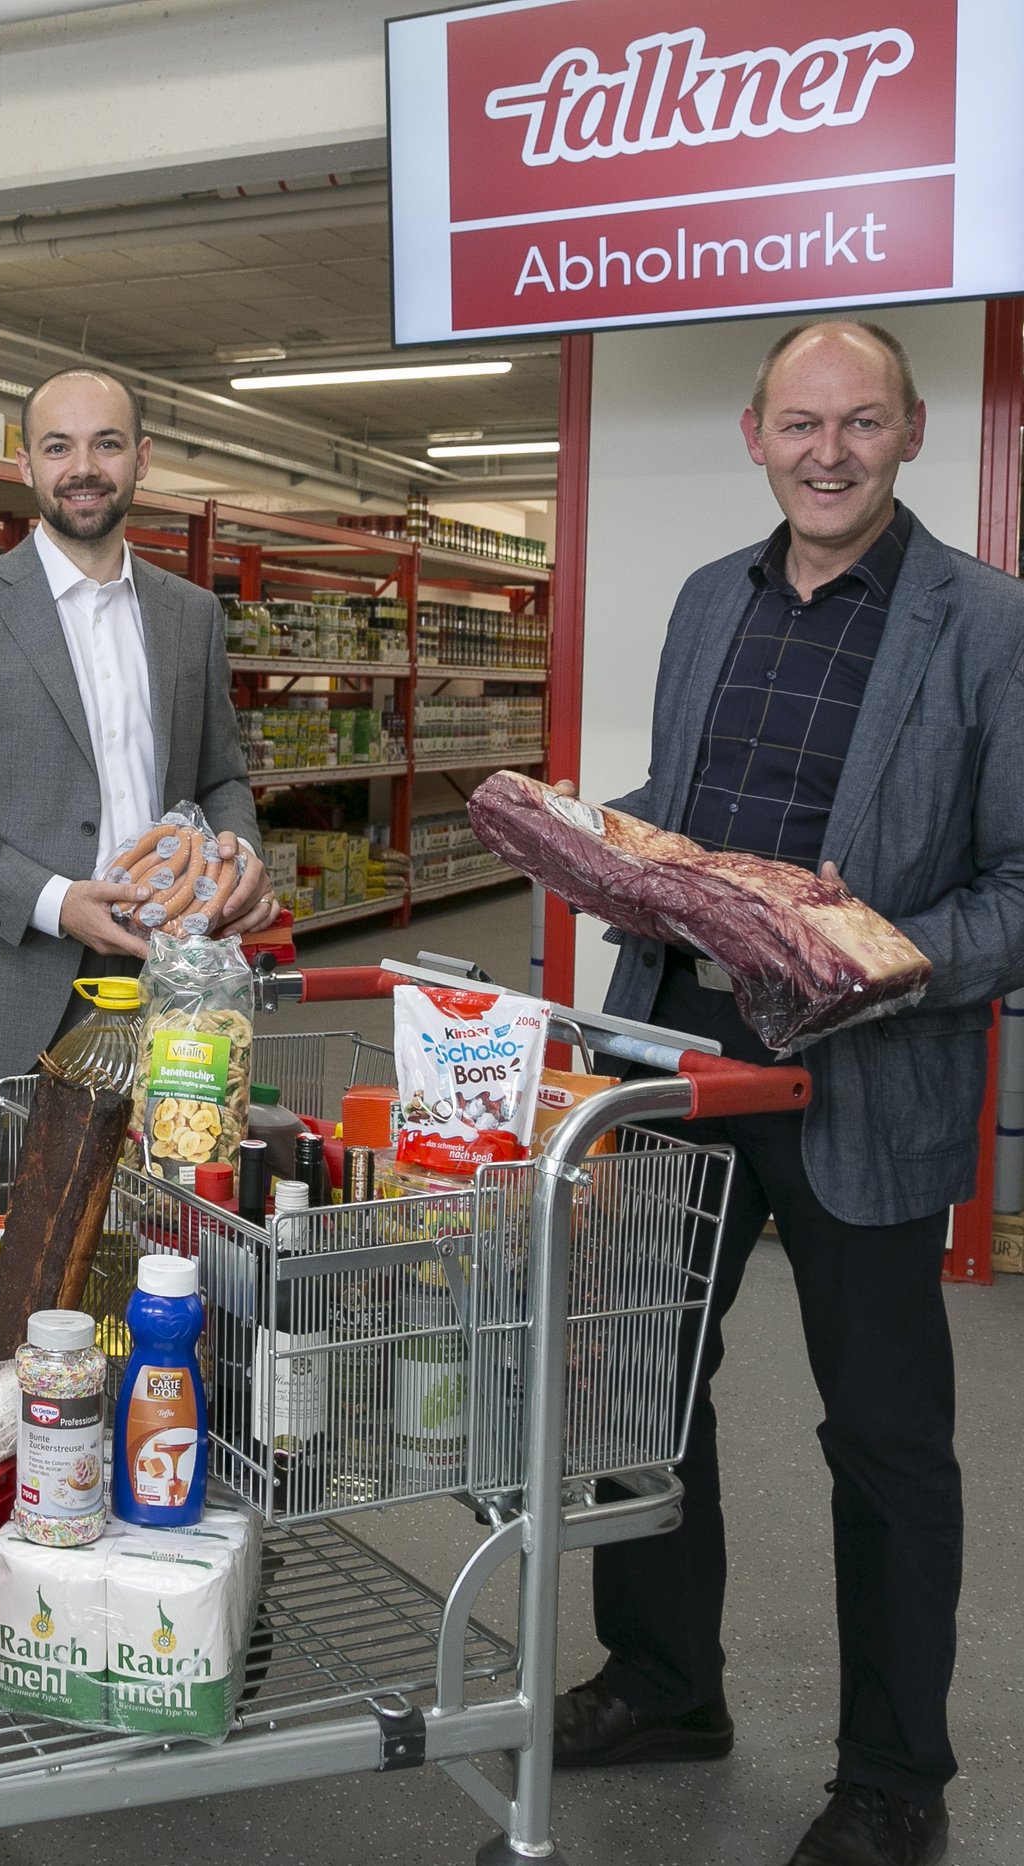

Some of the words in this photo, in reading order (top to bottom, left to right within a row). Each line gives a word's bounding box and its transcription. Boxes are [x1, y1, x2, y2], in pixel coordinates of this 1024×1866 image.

[485, 27, 915, 167] falkner
[513, 212, 887, 296] Abholmarkt
[515, 1017, 541, 1030] 200g
[445, 1026, 490, 1040] Kinder
[172, 1045, 207, 1062] Vitality
[437, 1040, 524, 1065] Schoko-
[160, 1066, 215, 1082] Bananenchips
[453, 1064, 507, 1085] Bons
[426, 1140, 437, 1148] das
[437, 1142, 465, 1151] schmeckt
[449, 1150, 471, 1160] nach
[472, 1151, 493, 1162] Spaß
[992, 1241, 1012, 1256] UR
[149, 1378, 181, 1391] CARTE
[153, 1388, 178, 1399] D'OR
[39, 1406, 58, 1416] Oetker
[157, 1409, 175, 1419] Toffee
[60, 1414, 99, 1427] Professional
[29, 1432, 51, 1443] Bunte
[29, 1441, 85, 1453] Zuckerstreusel
[0, 1624, 88, 1666] Rauch
[117, 1643, 211, 1677] Rauch
[0, 1661, 67, 1695] mehl
[0, 1682, 41, 1698] Weizenmehl
[40, 1691, 59, 1705] Type
[59, 1696, 73, 1705] 700
[117, 1680, 192, 1709] mehl
[118, 1701, 164, 1716] Weizenmehl
[164, 1708, 183, 1718] Type
[183, 1709, 198, 1717] 700
